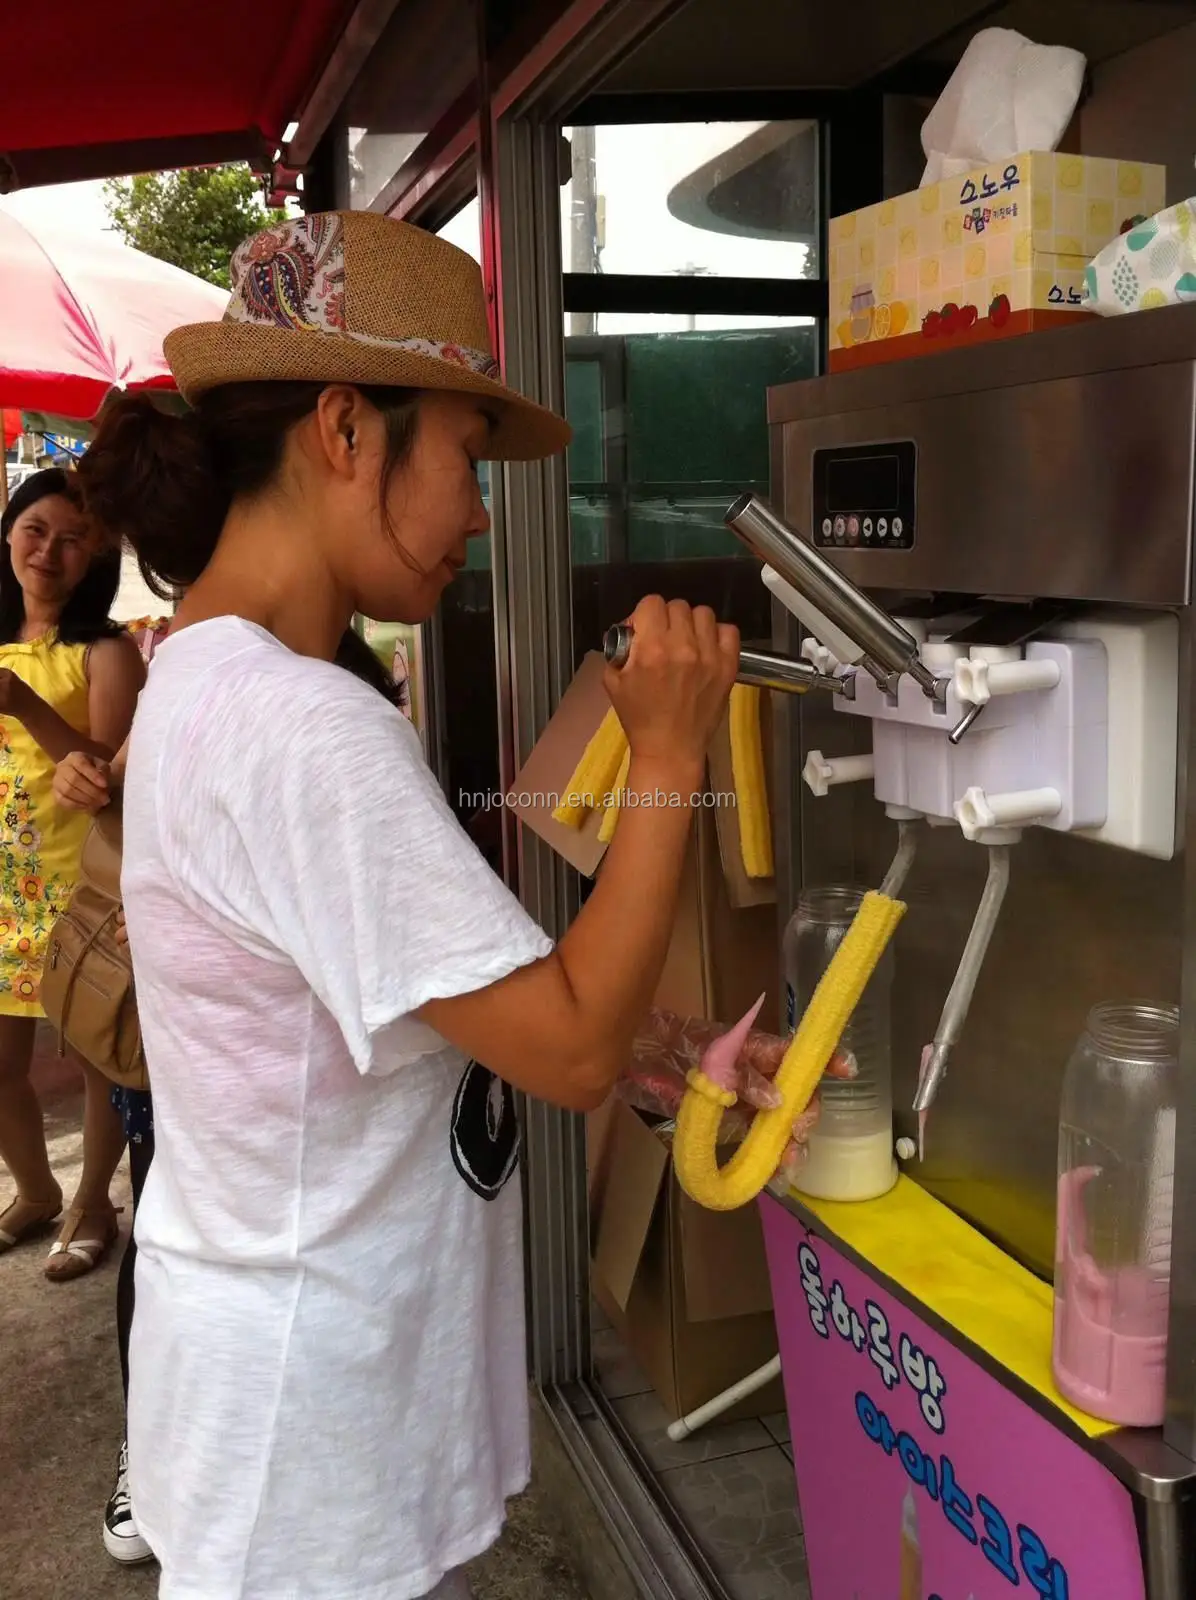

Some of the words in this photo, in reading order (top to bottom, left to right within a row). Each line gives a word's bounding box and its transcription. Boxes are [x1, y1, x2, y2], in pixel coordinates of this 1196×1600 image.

[959, 164, 1020, 205] 스노우
[1047, 284, 1089, 304] 스노
[797, 1241, 947, 1435] 돌하루방
